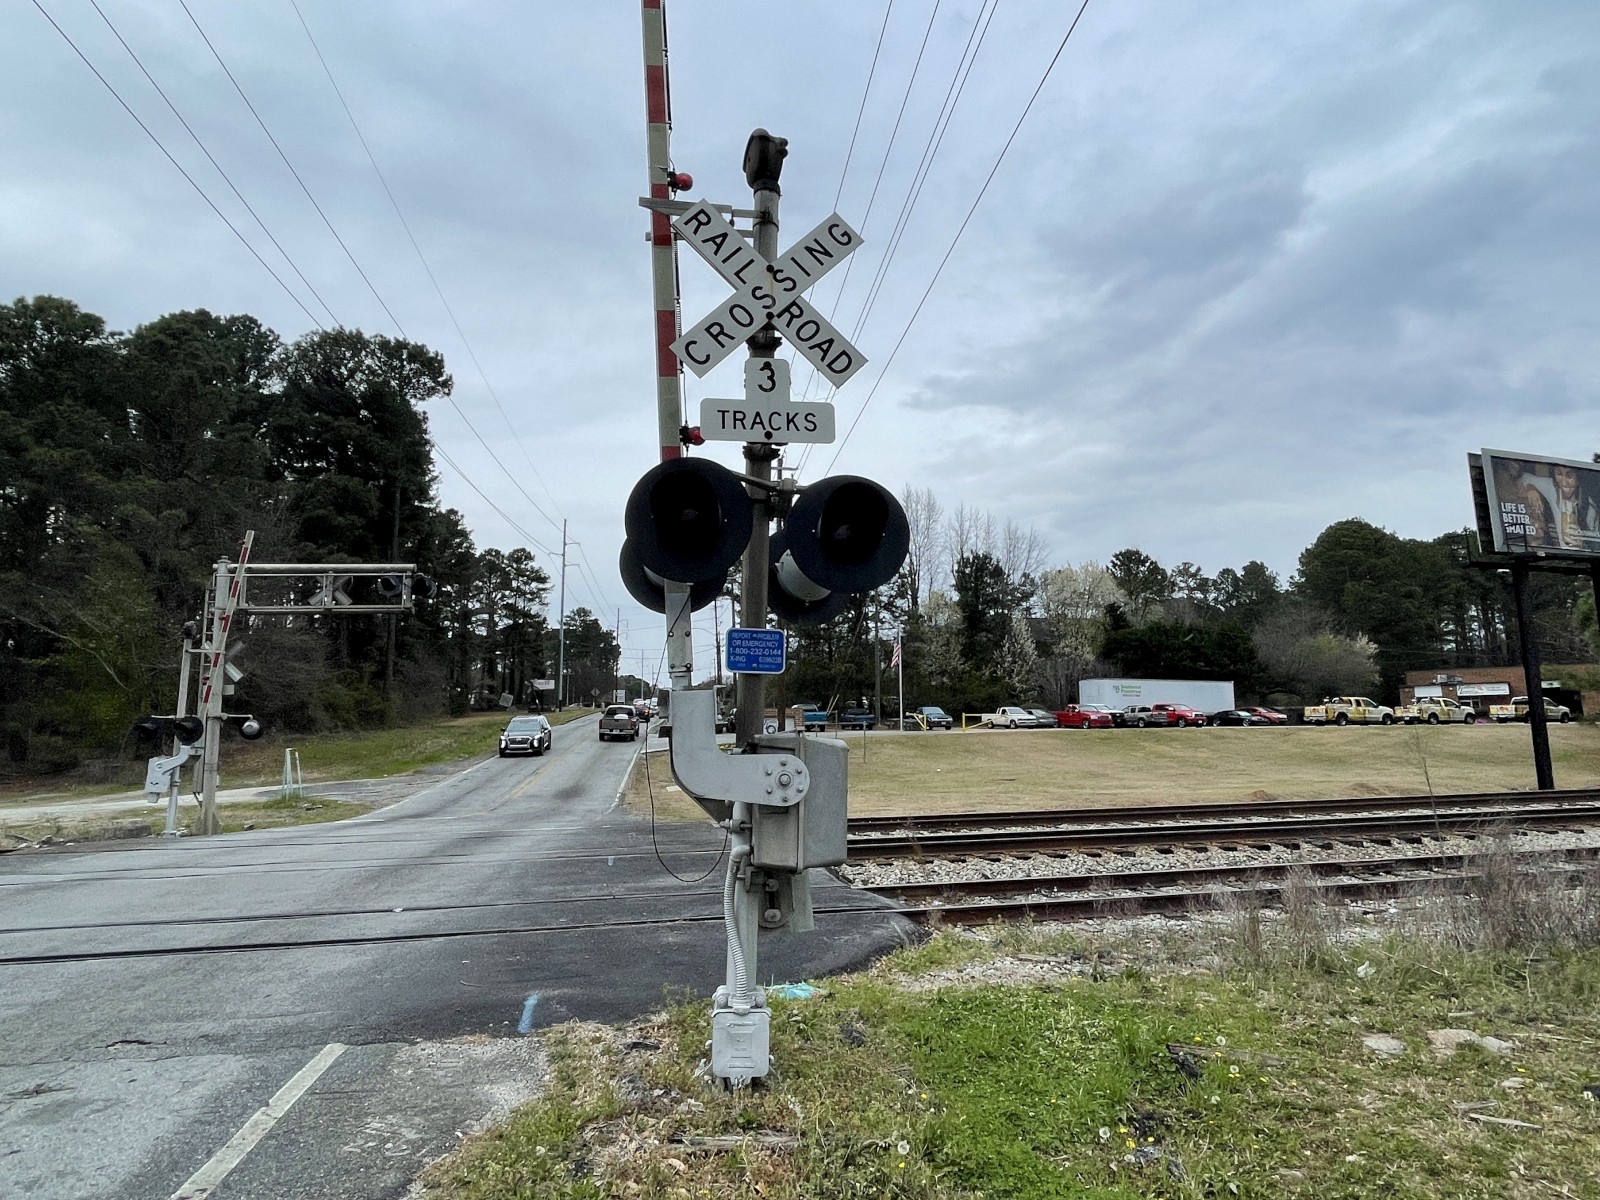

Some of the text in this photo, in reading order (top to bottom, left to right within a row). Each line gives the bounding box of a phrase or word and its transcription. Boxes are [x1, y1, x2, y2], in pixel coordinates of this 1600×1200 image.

[683, 207, 853, 375] RAIL ROAD
[684, 223, 853, 366] CROSSING
[757, 362, 777, 393] 3
[717, 409, 818, 432] TRACKS
[1501, 502, 1526, 513] LIFE IS
[1502, 513, 1530, 524] BETTER
